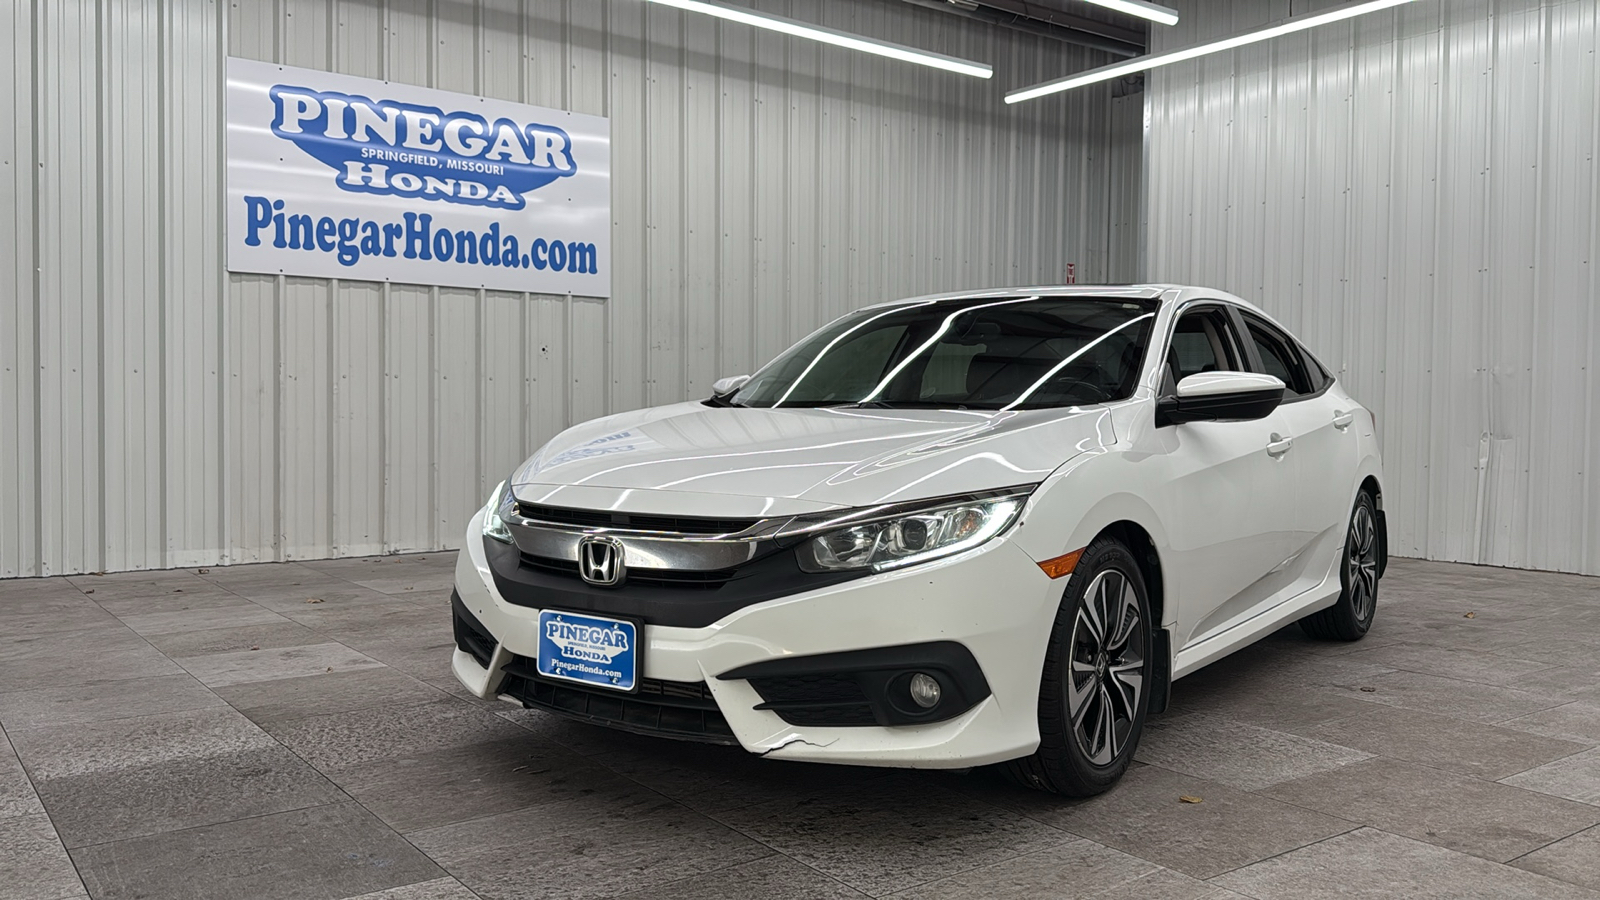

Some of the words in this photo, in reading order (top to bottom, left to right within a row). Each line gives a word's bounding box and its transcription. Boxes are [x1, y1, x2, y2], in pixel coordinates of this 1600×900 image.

[276, 92, 571, 171] PINEGAR
[361, 147, 443, 169] SPRINGFIELD,
[446, 159, 504, 175] MISSOURI
[342, 160, 520, 204] HONDA
[244, 196, 598, 274] PinegarHonda.com
[547, 623, 627, 648] PINEGAR
[551, 658, 622, 678] PinegarHonda.com
[563, 646, 611, 662] HONDA
